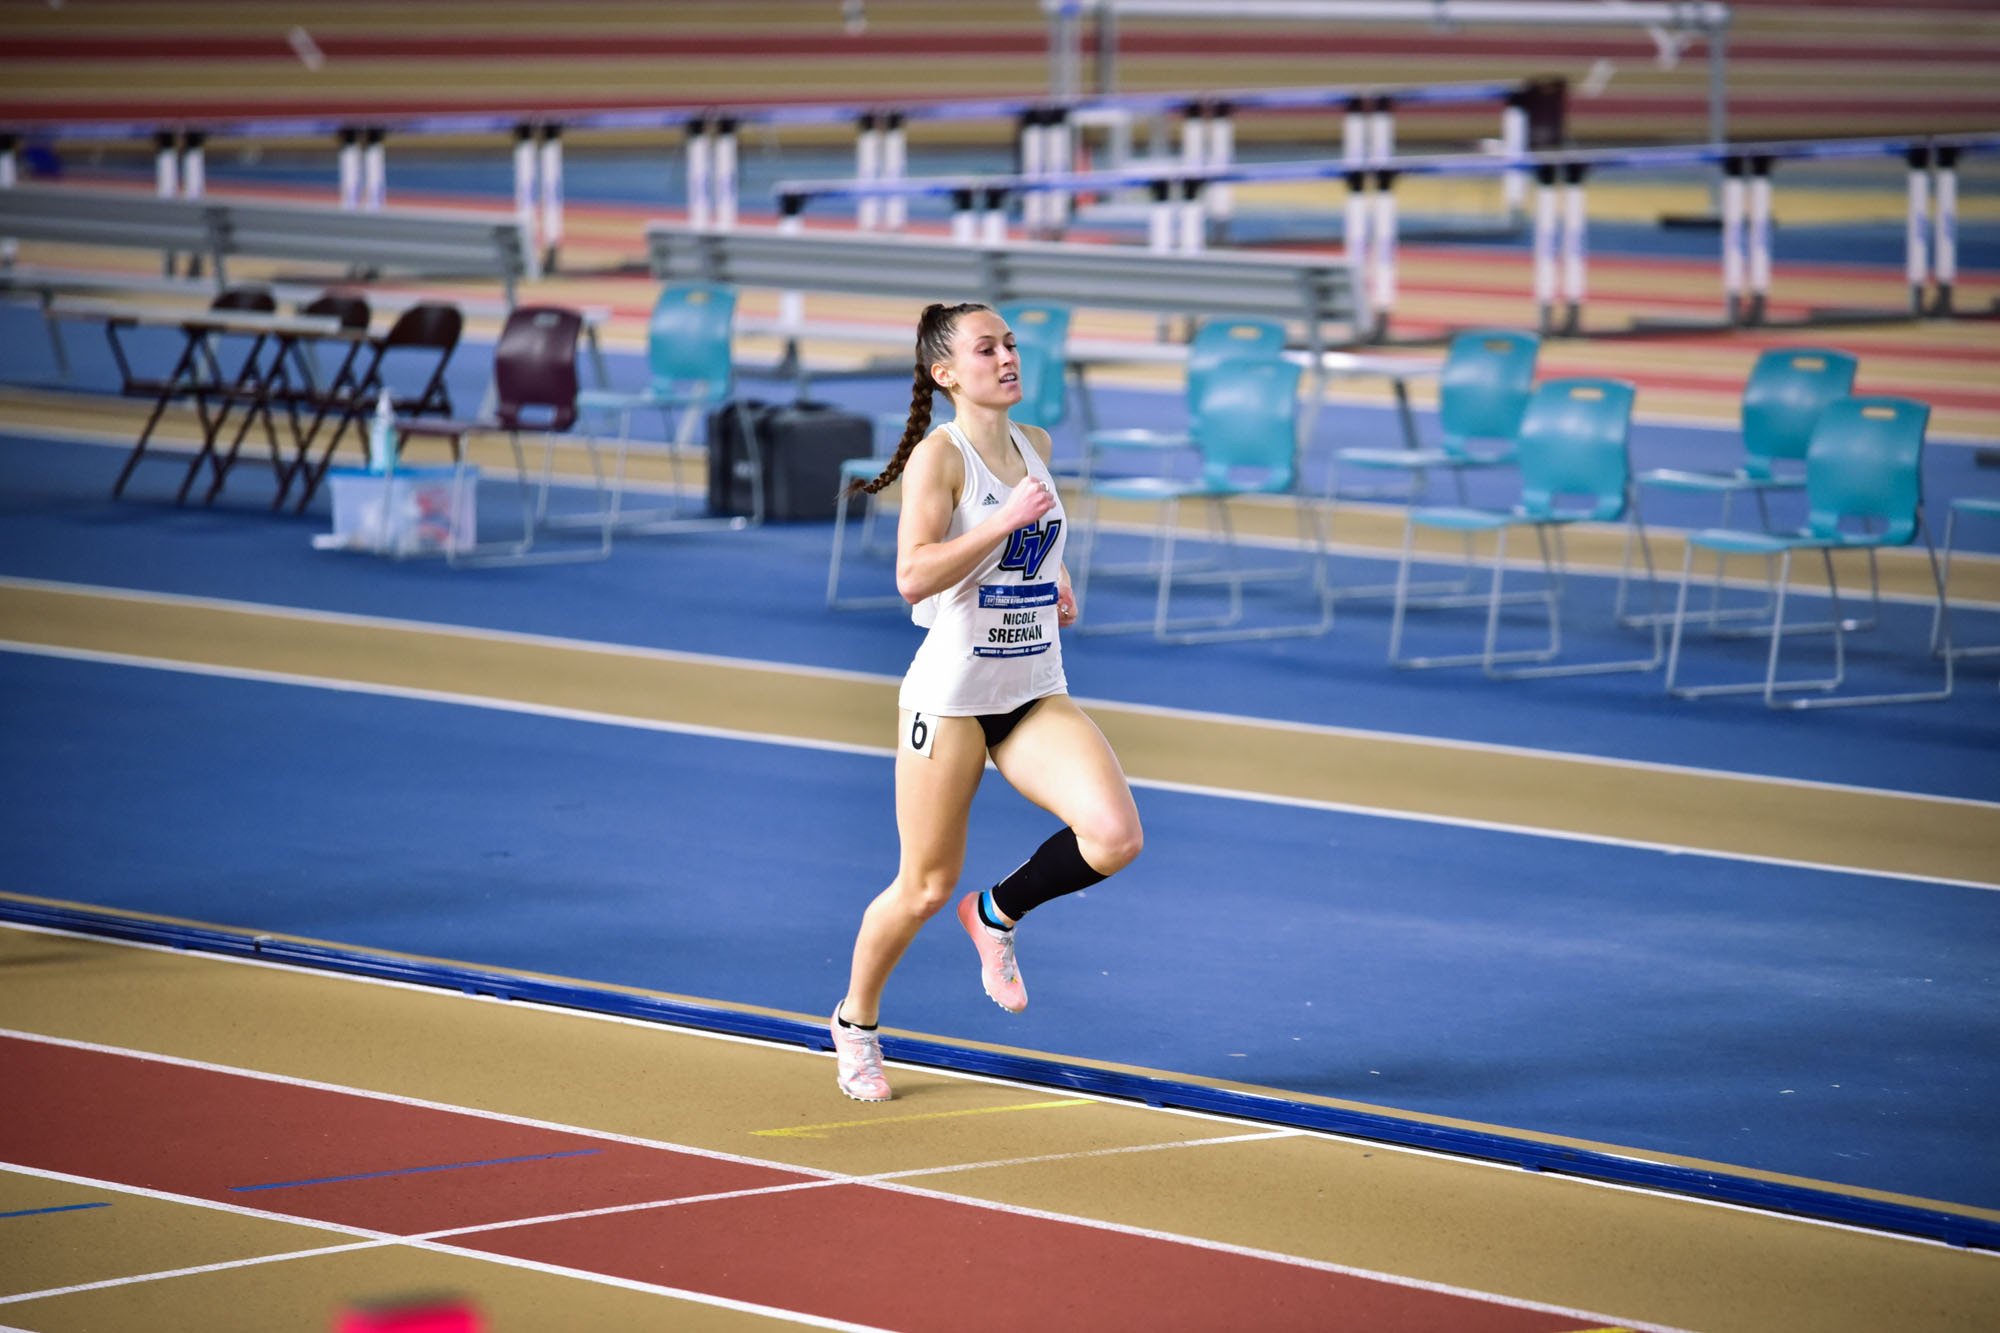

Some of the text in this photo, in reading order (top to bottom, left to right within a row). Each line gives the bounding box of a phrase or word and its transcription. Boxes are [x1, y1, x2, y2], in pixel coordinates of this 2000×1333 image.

[997, 519, 1062, 581] GV
[1003, 611, 1037, 625] NICOLE
[988, 624, 1042, 643] SREENAN
[912, 711, 928, 750] 6
